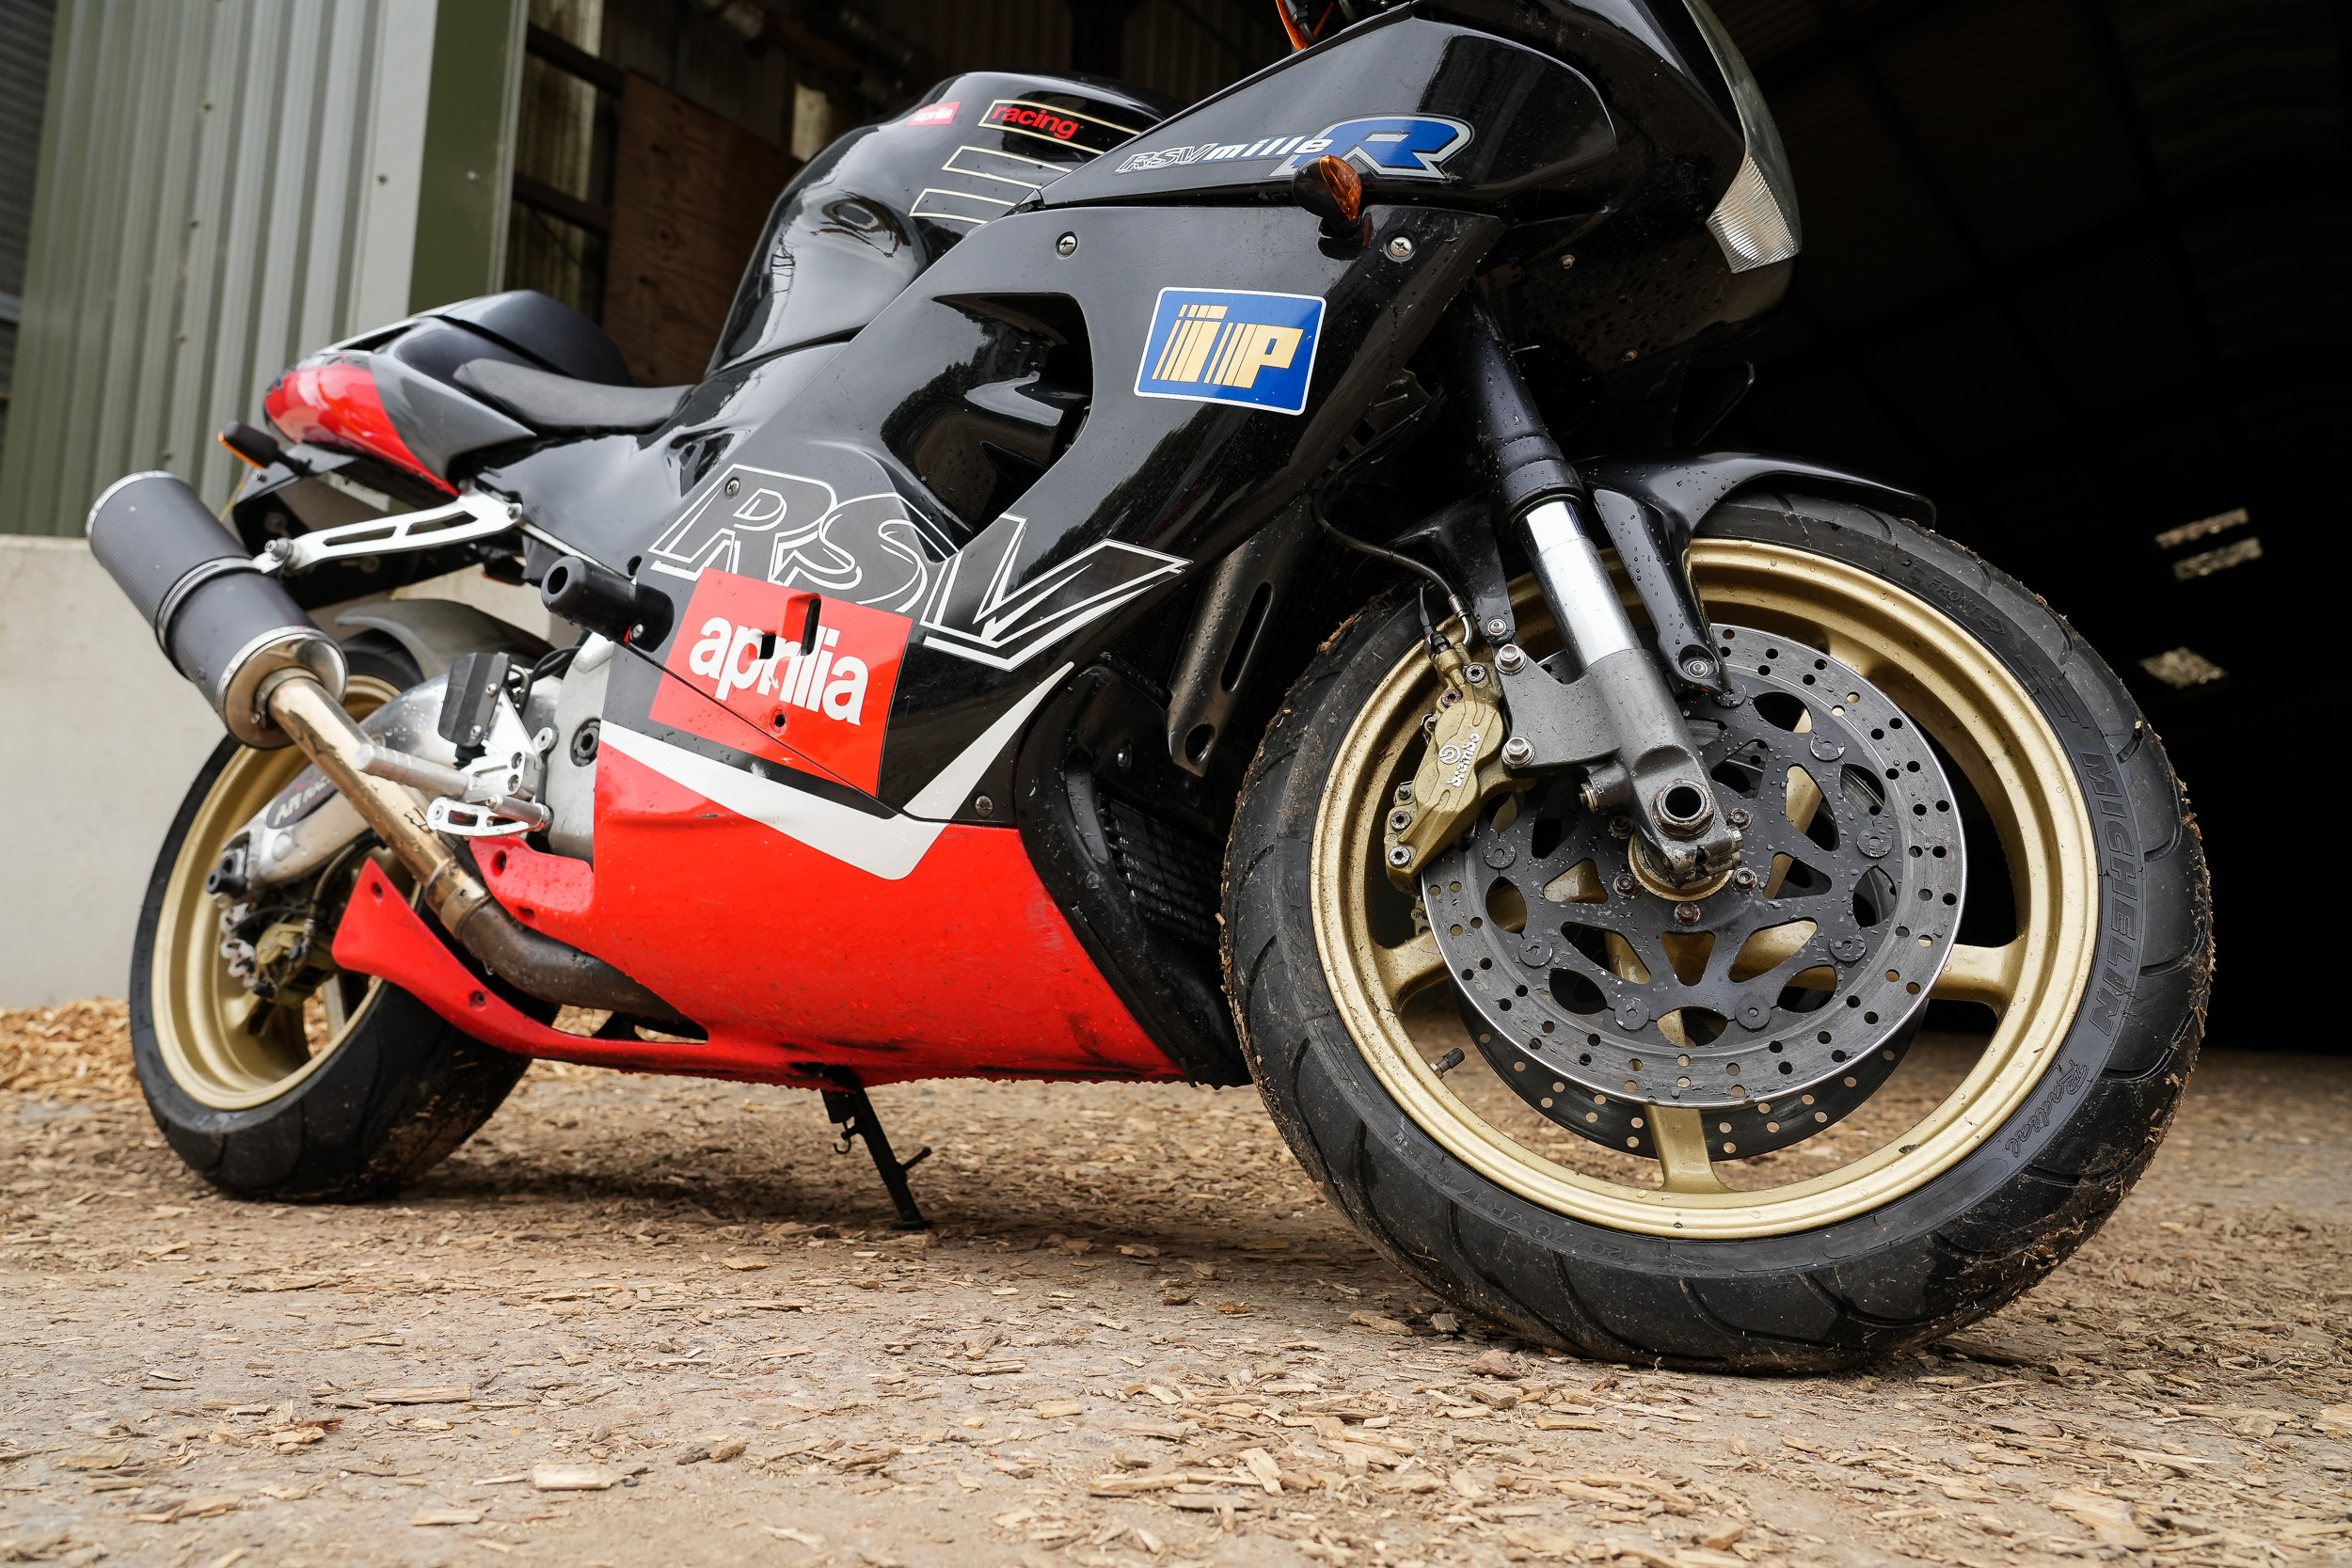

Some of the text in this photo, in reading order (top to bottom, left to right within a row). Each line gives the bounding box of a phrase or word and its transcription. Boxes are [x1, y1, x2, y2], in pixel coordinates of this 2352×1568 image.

[991, 105, 1080, 140] racing
[649, 464, 1193, 672] RSV
[1929, 578, 1982, 616] FRONT
[689, 616, 863, 726] aprilia
[1446, 732, 1481, 788] brembo
[2079, 752, 2142, 1037] MICHELIN
[2005, 1057, 2090, 1159] Radial
